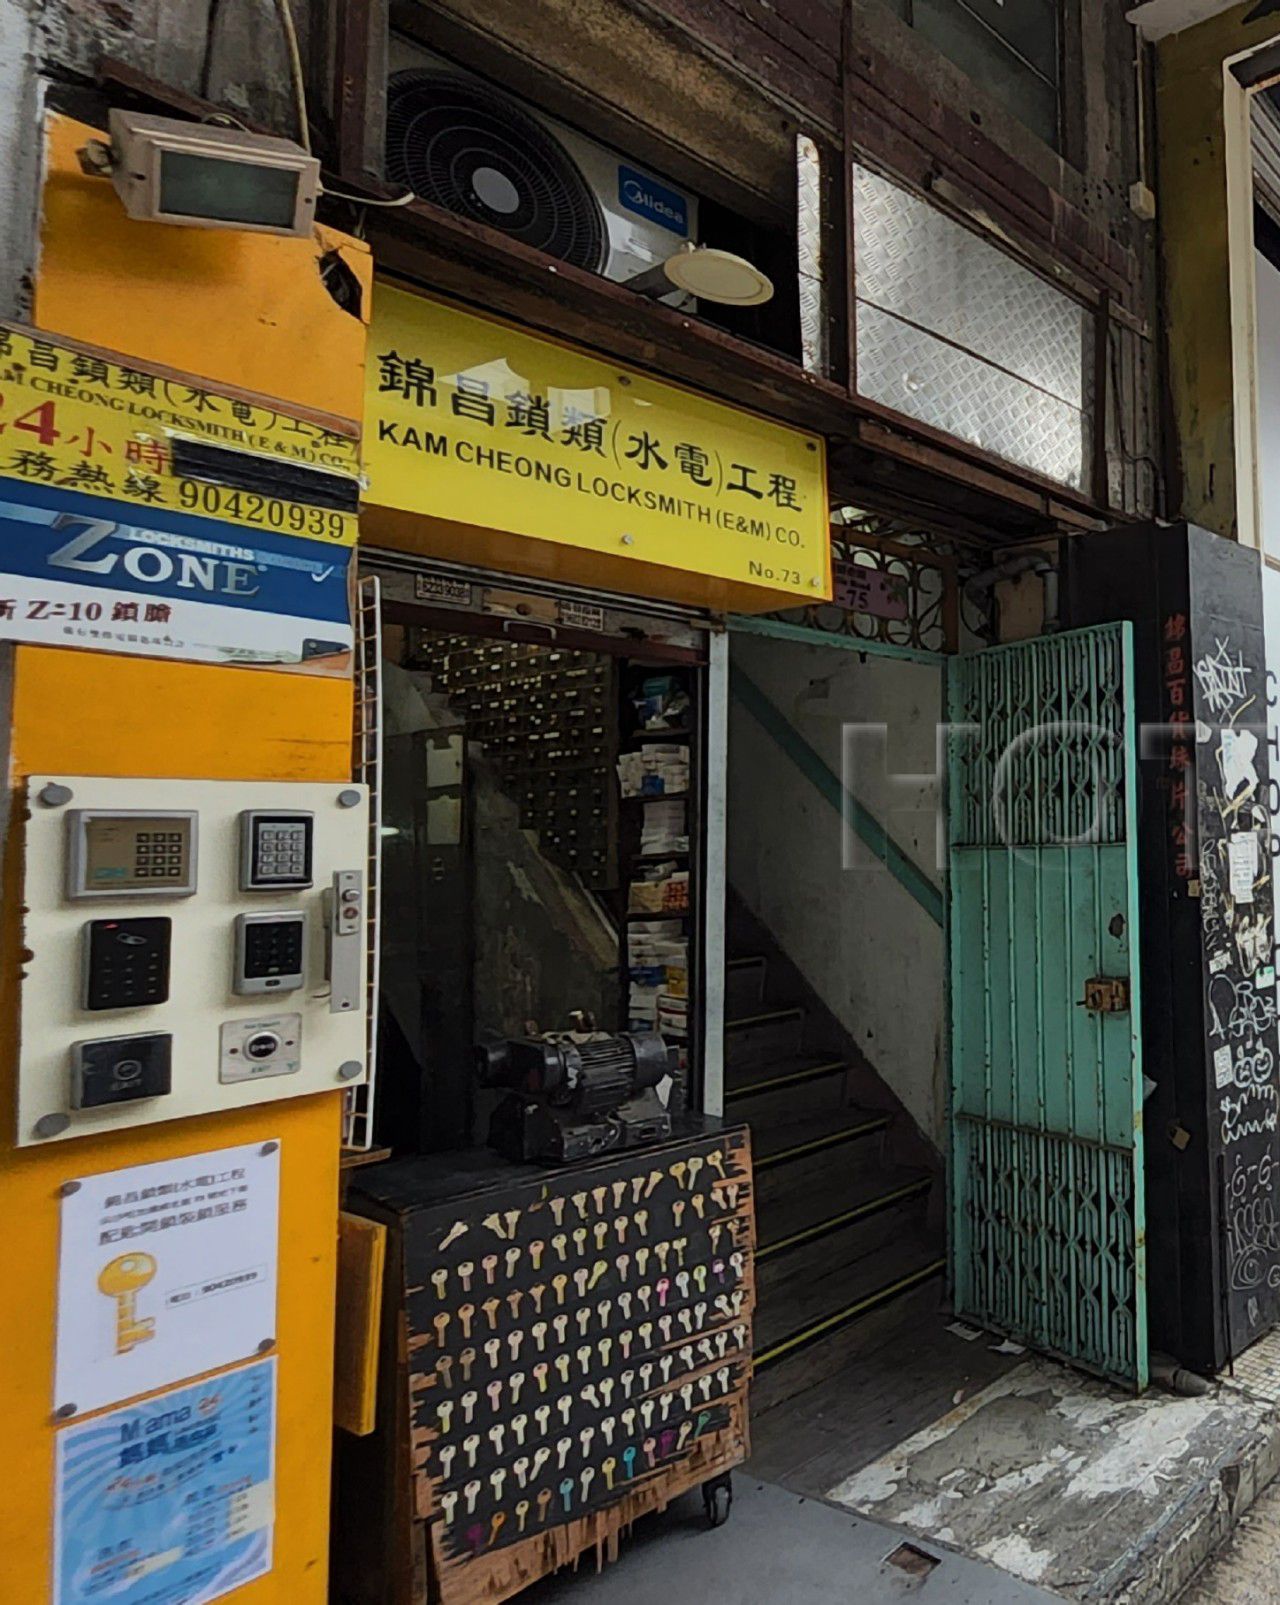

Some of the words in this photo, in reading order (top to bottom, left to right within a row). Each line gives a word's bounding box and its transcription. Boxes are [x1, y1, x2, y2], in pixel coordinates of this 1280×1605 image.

[623, 180, 684, 225] Midea
[0, 392, 169, 475] 4小時
[30, 376, 125, 412] CHEONG
[129, 402, 244, 443] LOCKSMITH
[0, 449, 168, 504] 務熱線
[179, 480, 345, 539] 90420939
[378, 420, 448, 458] KAM
[455, 441, 571, 488] CHEONG
[578, 476, 711, 525] LOCKSMITH
[716, 506, 771, 543] (E&M)
[776, 527, 805, 548] CO.
[48, 511, 260, 596] ZONE
